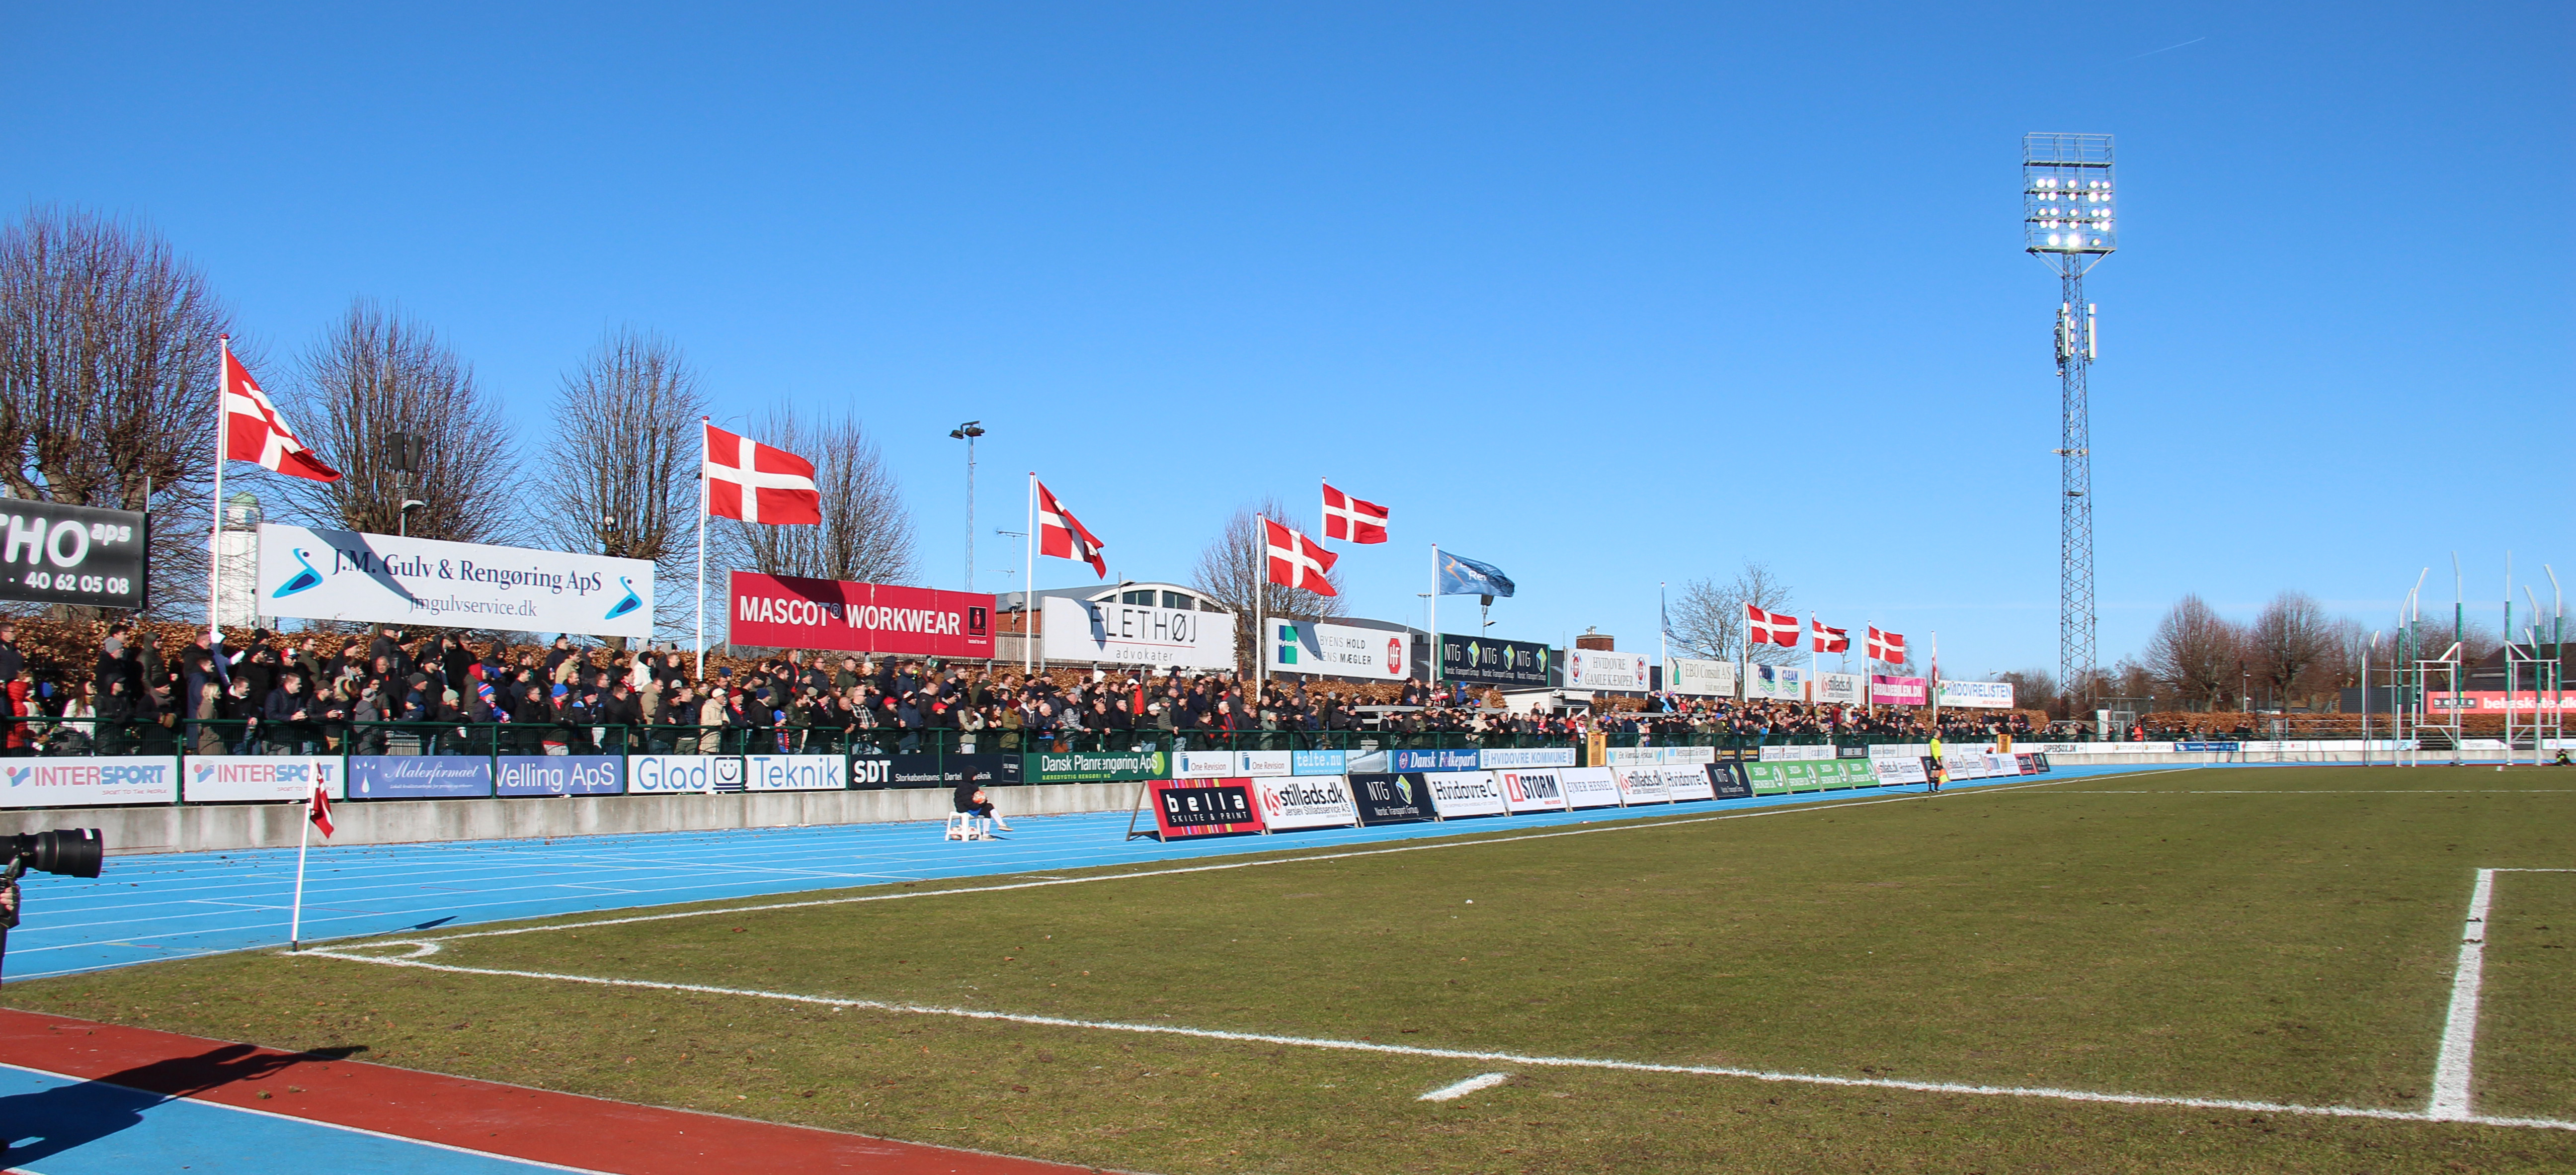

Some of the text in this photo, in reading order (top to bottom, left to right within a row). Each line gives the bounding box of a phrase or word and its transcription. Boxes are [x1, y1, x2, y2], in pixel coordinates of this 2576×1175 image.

[91, 523, 132, 546] aps
[332, 548, 602, 596] J.M. Gulv & Rengøring ApS
[25, 572, 130, 594] 40 62 05 08
[408, 593, 537, 617] jmgulvservice.dk
[846, 604, 961, 636] WORKWEAR
[1091, 605, 1197, 643] FLETHØJ
[1320, 635, 1366, 650] BYENS HOLD
[1116, 647, 1174, 662] advokater
[1313, 651, 1371, 666] BYENS MÆGLER
[1445, 643, 1461, 662] NTG
[1482, 647, 1497, 665] NTG
[1517, 650, 1530, 667] NTG
[1593, 657, 1626, 670] HVIDOVRE
[1585, 672, 1607, 685] GAMLE
[1042, 754, 1158, 774] Dansk Planrengøring ApS
[1191, 762, 1226, 771] One Revision
[1252, 761, 1285, 770] One Revision
[1296, 751, 1342, 766] telte.nu
[1410, 752, 1477, 771] Dansk Folkeparti
[1491, 751, 1567, 765] HVIDOVRE KOMMUNE
[35, 765, 166, 786] INTERSPORT
[218, 764, 334, 783] INTERSPOT
[385, 759, 481, 784] Malerfirmaet
[486, 762, 615, 793] Welling ApS
[638, 757, 839, 790] Glad Teknik
[853, 759, 891, 783] SDT
[895, 773, 940, 782] Storkøbenhavns
[1279, 782, 1348, 806] stillads.dk
[1366, 781, 1390, 801] NTG
[1432, 779, 1498, 801] Hvidovre C
[1520, 775, 1559, 799] STORM
[1566, 780, 1613, 794] EJNER HESSEL
[1166, 791, 1246, 813] bella
[1285, 807, 1304, 816] Jerslev
[1303, 804, 1341, 815] Stilladsservice
[1171, 811, 1248, 823] SKILTE & PRINT
